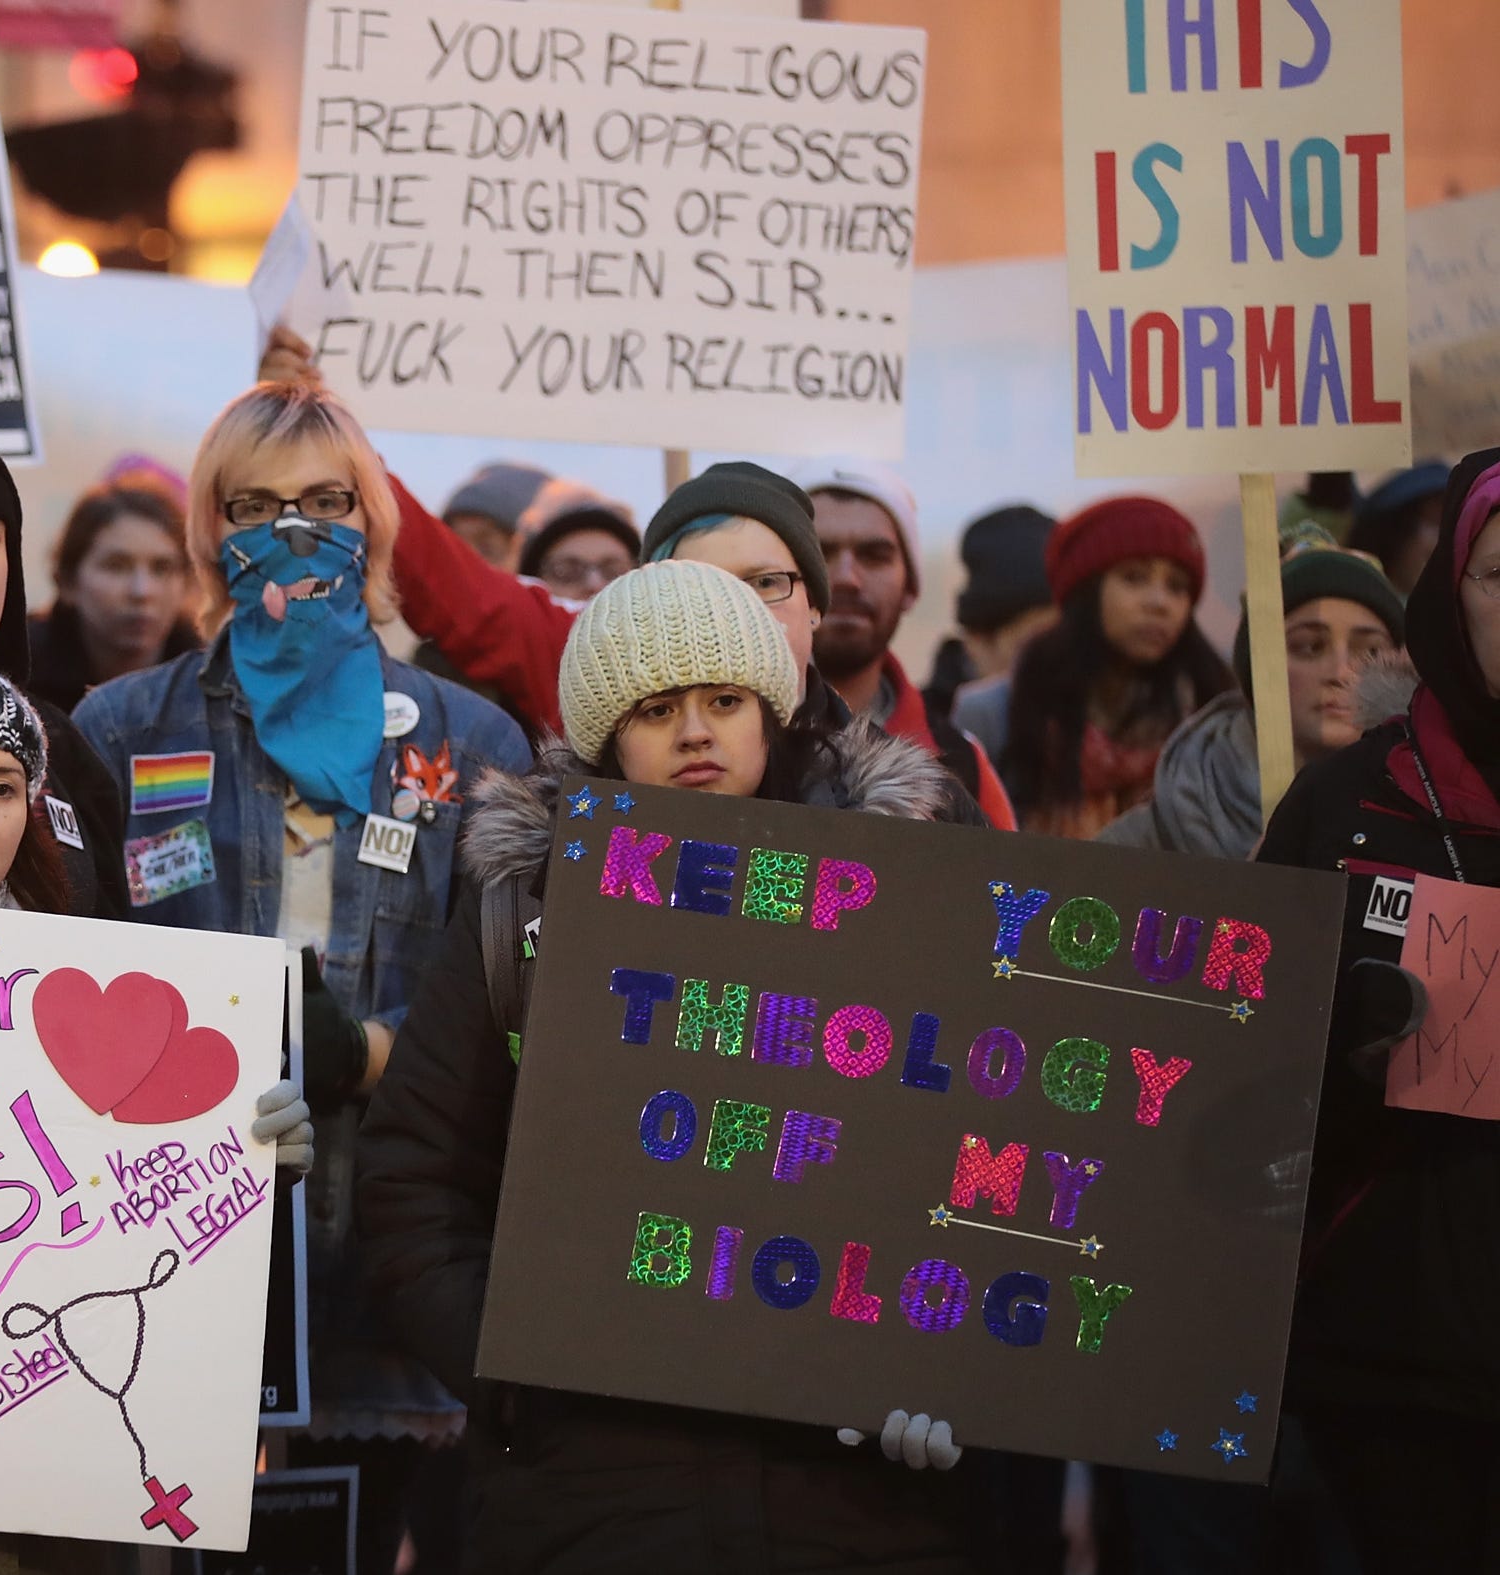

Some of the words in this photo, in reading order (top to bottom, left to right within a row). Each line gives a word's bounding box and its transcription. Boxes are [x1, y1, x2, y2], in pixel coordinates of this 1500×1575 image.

[325, 7, 392, 71] IF
[428, 18, 586, 84] YOUR
[605, 33, 922, 109] RELIGOUS
[1125, 0, 1331, 94] THIS
[317, 97, 570, 162] FREEDOM
[595, 110, 912, 188] OPPRESSES
[303, 172, 428, 230] THE
[463, 178, 648, 237] RIGHTS
[676, 190, 749, 237] OF
[1095, 141, 1183, 272] IS
[1226, 133, 1391, 264] NOT
[317, 241, 482, 299] WELL
[506, 248, 665, 301] THEN
[695, 252, 896, 325] SIR...
[317, 317, 465, 389] FUCK
[499, 324, 645, 397] YOUR
[666, 331, 902, 404] RELIGION
[1076, 303, 1402, 434] NORMAL
[49, 803, 79, 836] NO!
[364, 821, 413, 858] NO!
[1443, 834, 1459, 868] UNDER
[599, 825, 877, 932] KEEP
[987, 879, 1273, 1000] YOUR
[1426, 912, 1500, 1021] My
[609, 967, 1193, 1127] THEOLOGY
[109, 1125, 244, 1234] ABORTION
[639, 1089, 843, 1184] OFF
[950, 1133, 1106, 1230] MY
[165, 1167, 270, 1253] LEGAL
[627, 1211, 1133, 1354] BIOLOGY
